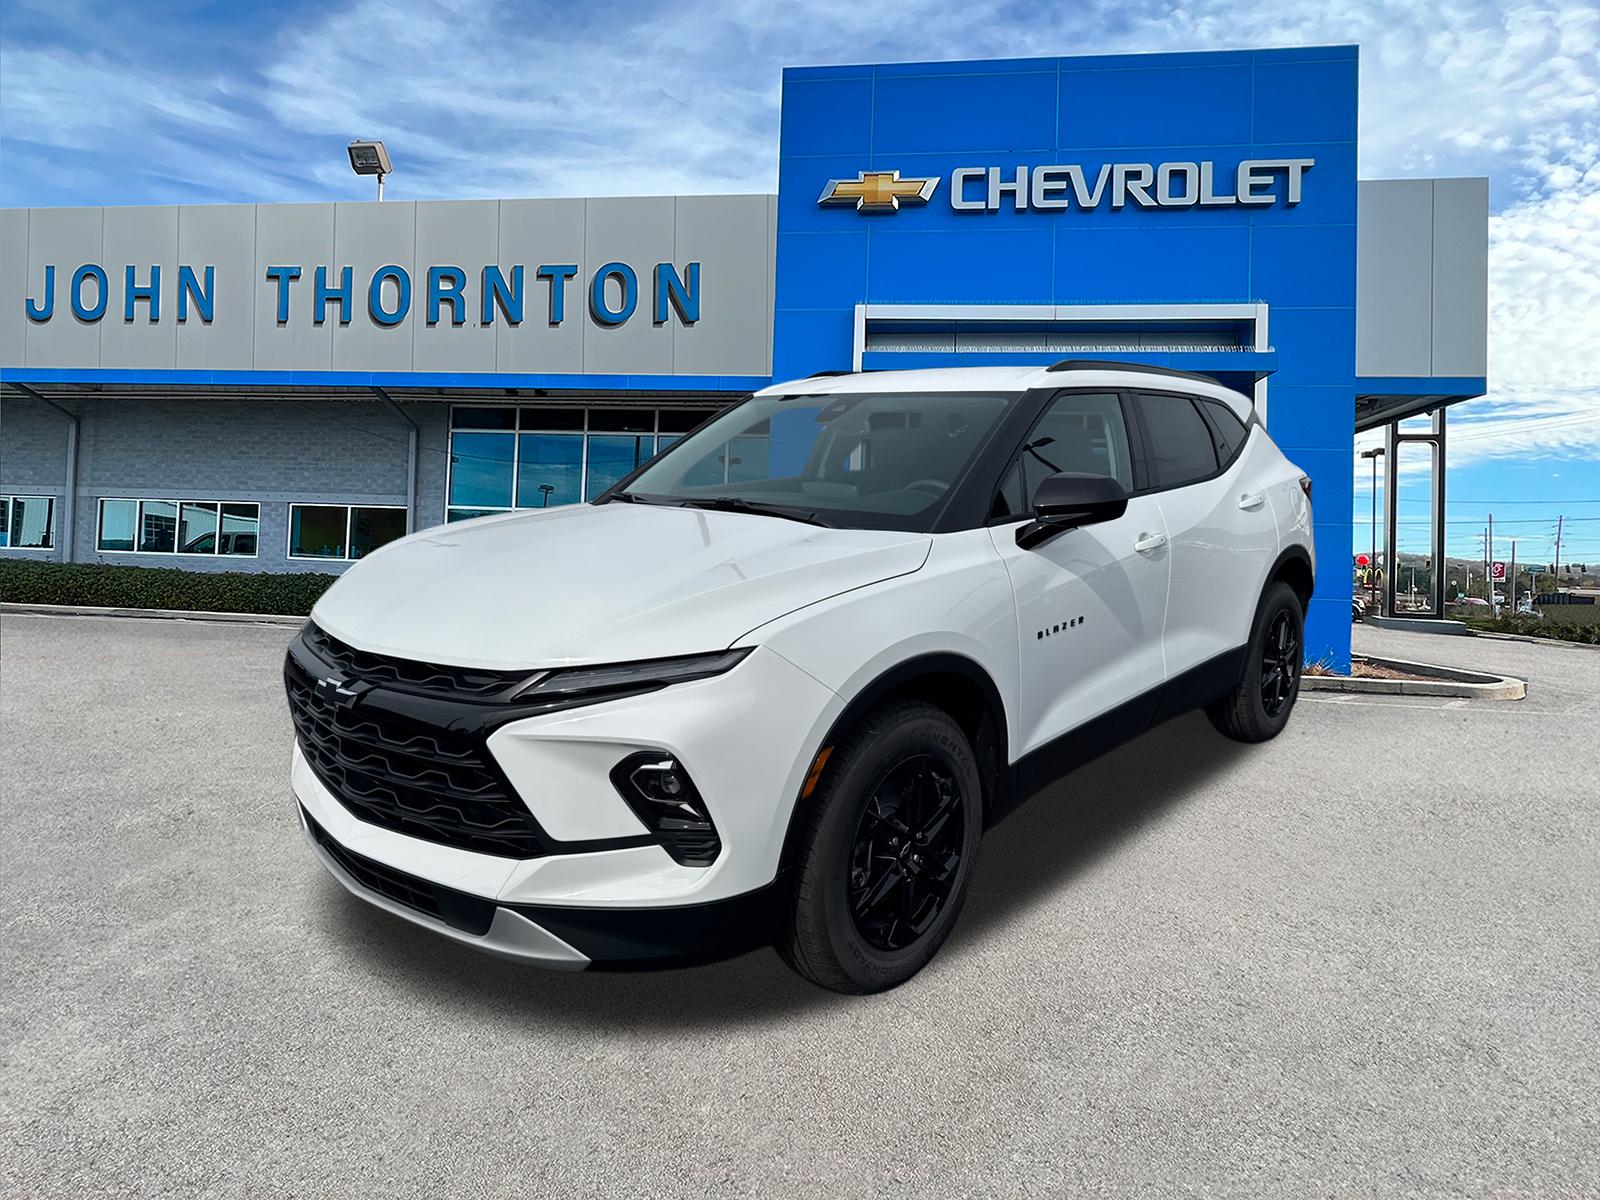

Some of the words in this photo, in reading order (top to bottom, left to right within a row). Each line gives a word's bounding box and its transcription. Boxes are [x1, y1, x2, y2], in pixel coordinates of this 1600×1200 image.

[951, 158, 1315, 209] CHEVROLET
[25, 263, 215, 324] JOHN
[265, 262, 700, 328] THORNTON
[1037, 616, 1084, 640] BLAZER
